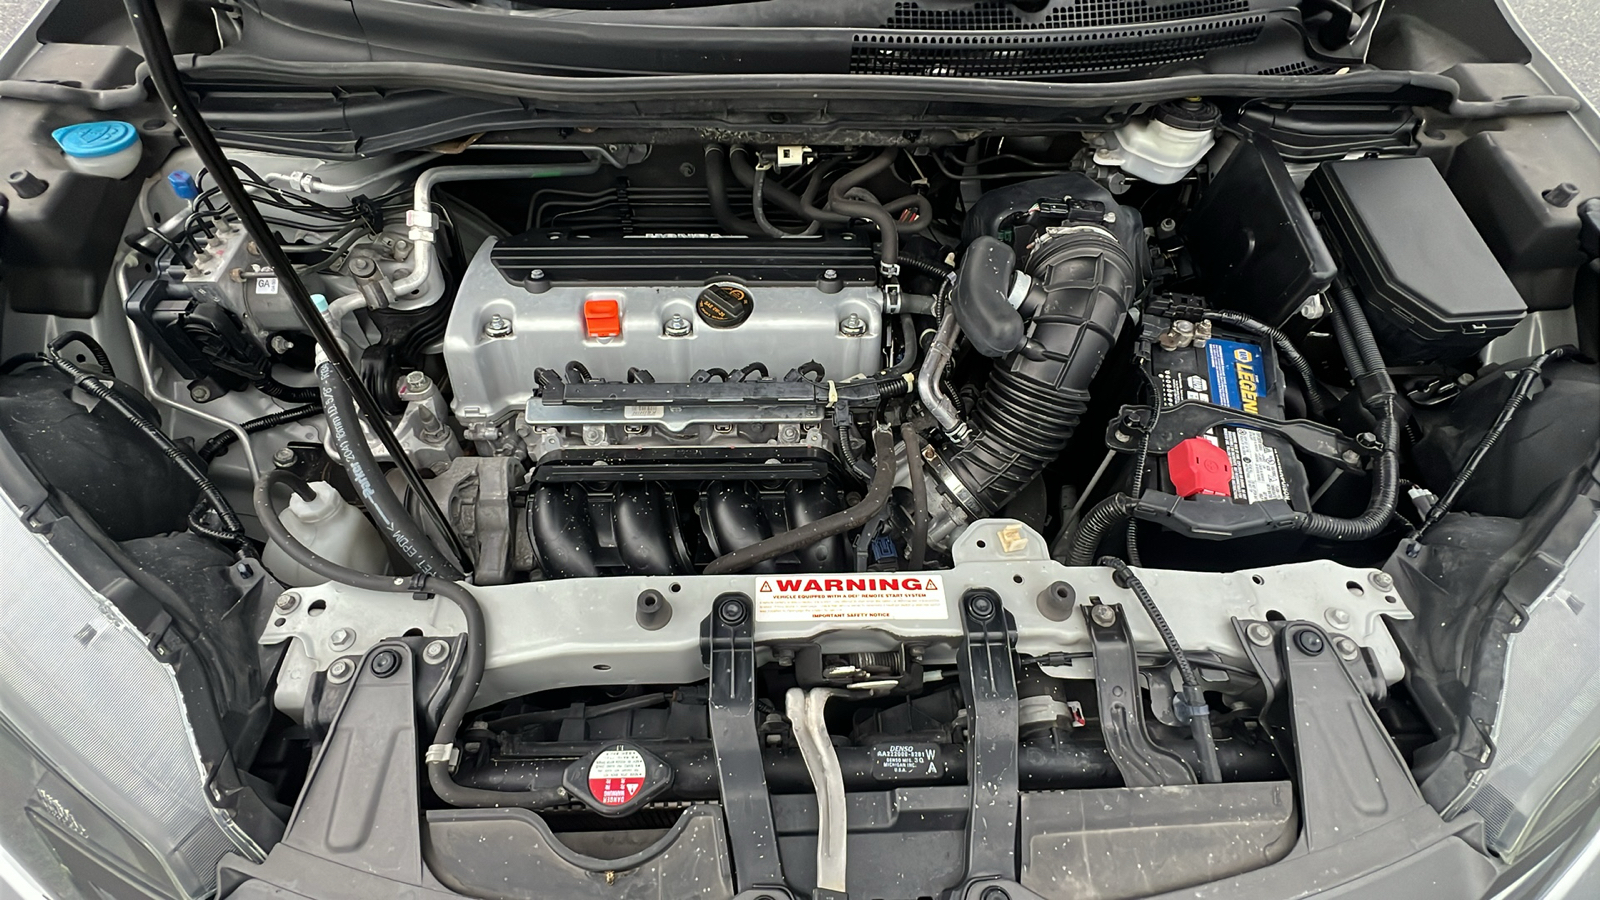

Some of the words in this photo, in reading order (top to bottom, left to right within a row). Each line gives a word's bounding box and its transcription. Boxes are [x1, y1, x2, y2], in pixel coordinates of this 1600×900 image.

[258, 279, 270, 288] GA
[1236, 362, 1259, 415] LEGEN
[340, 440, 355, 462] 2041
[350, 462, 375, 498] Parker
[392, 530, 418, 557] EPDM
[776, 578, 922, 592] WARNING
[925, 749, 935, 760] W
[927, 761, 938, 774] A
